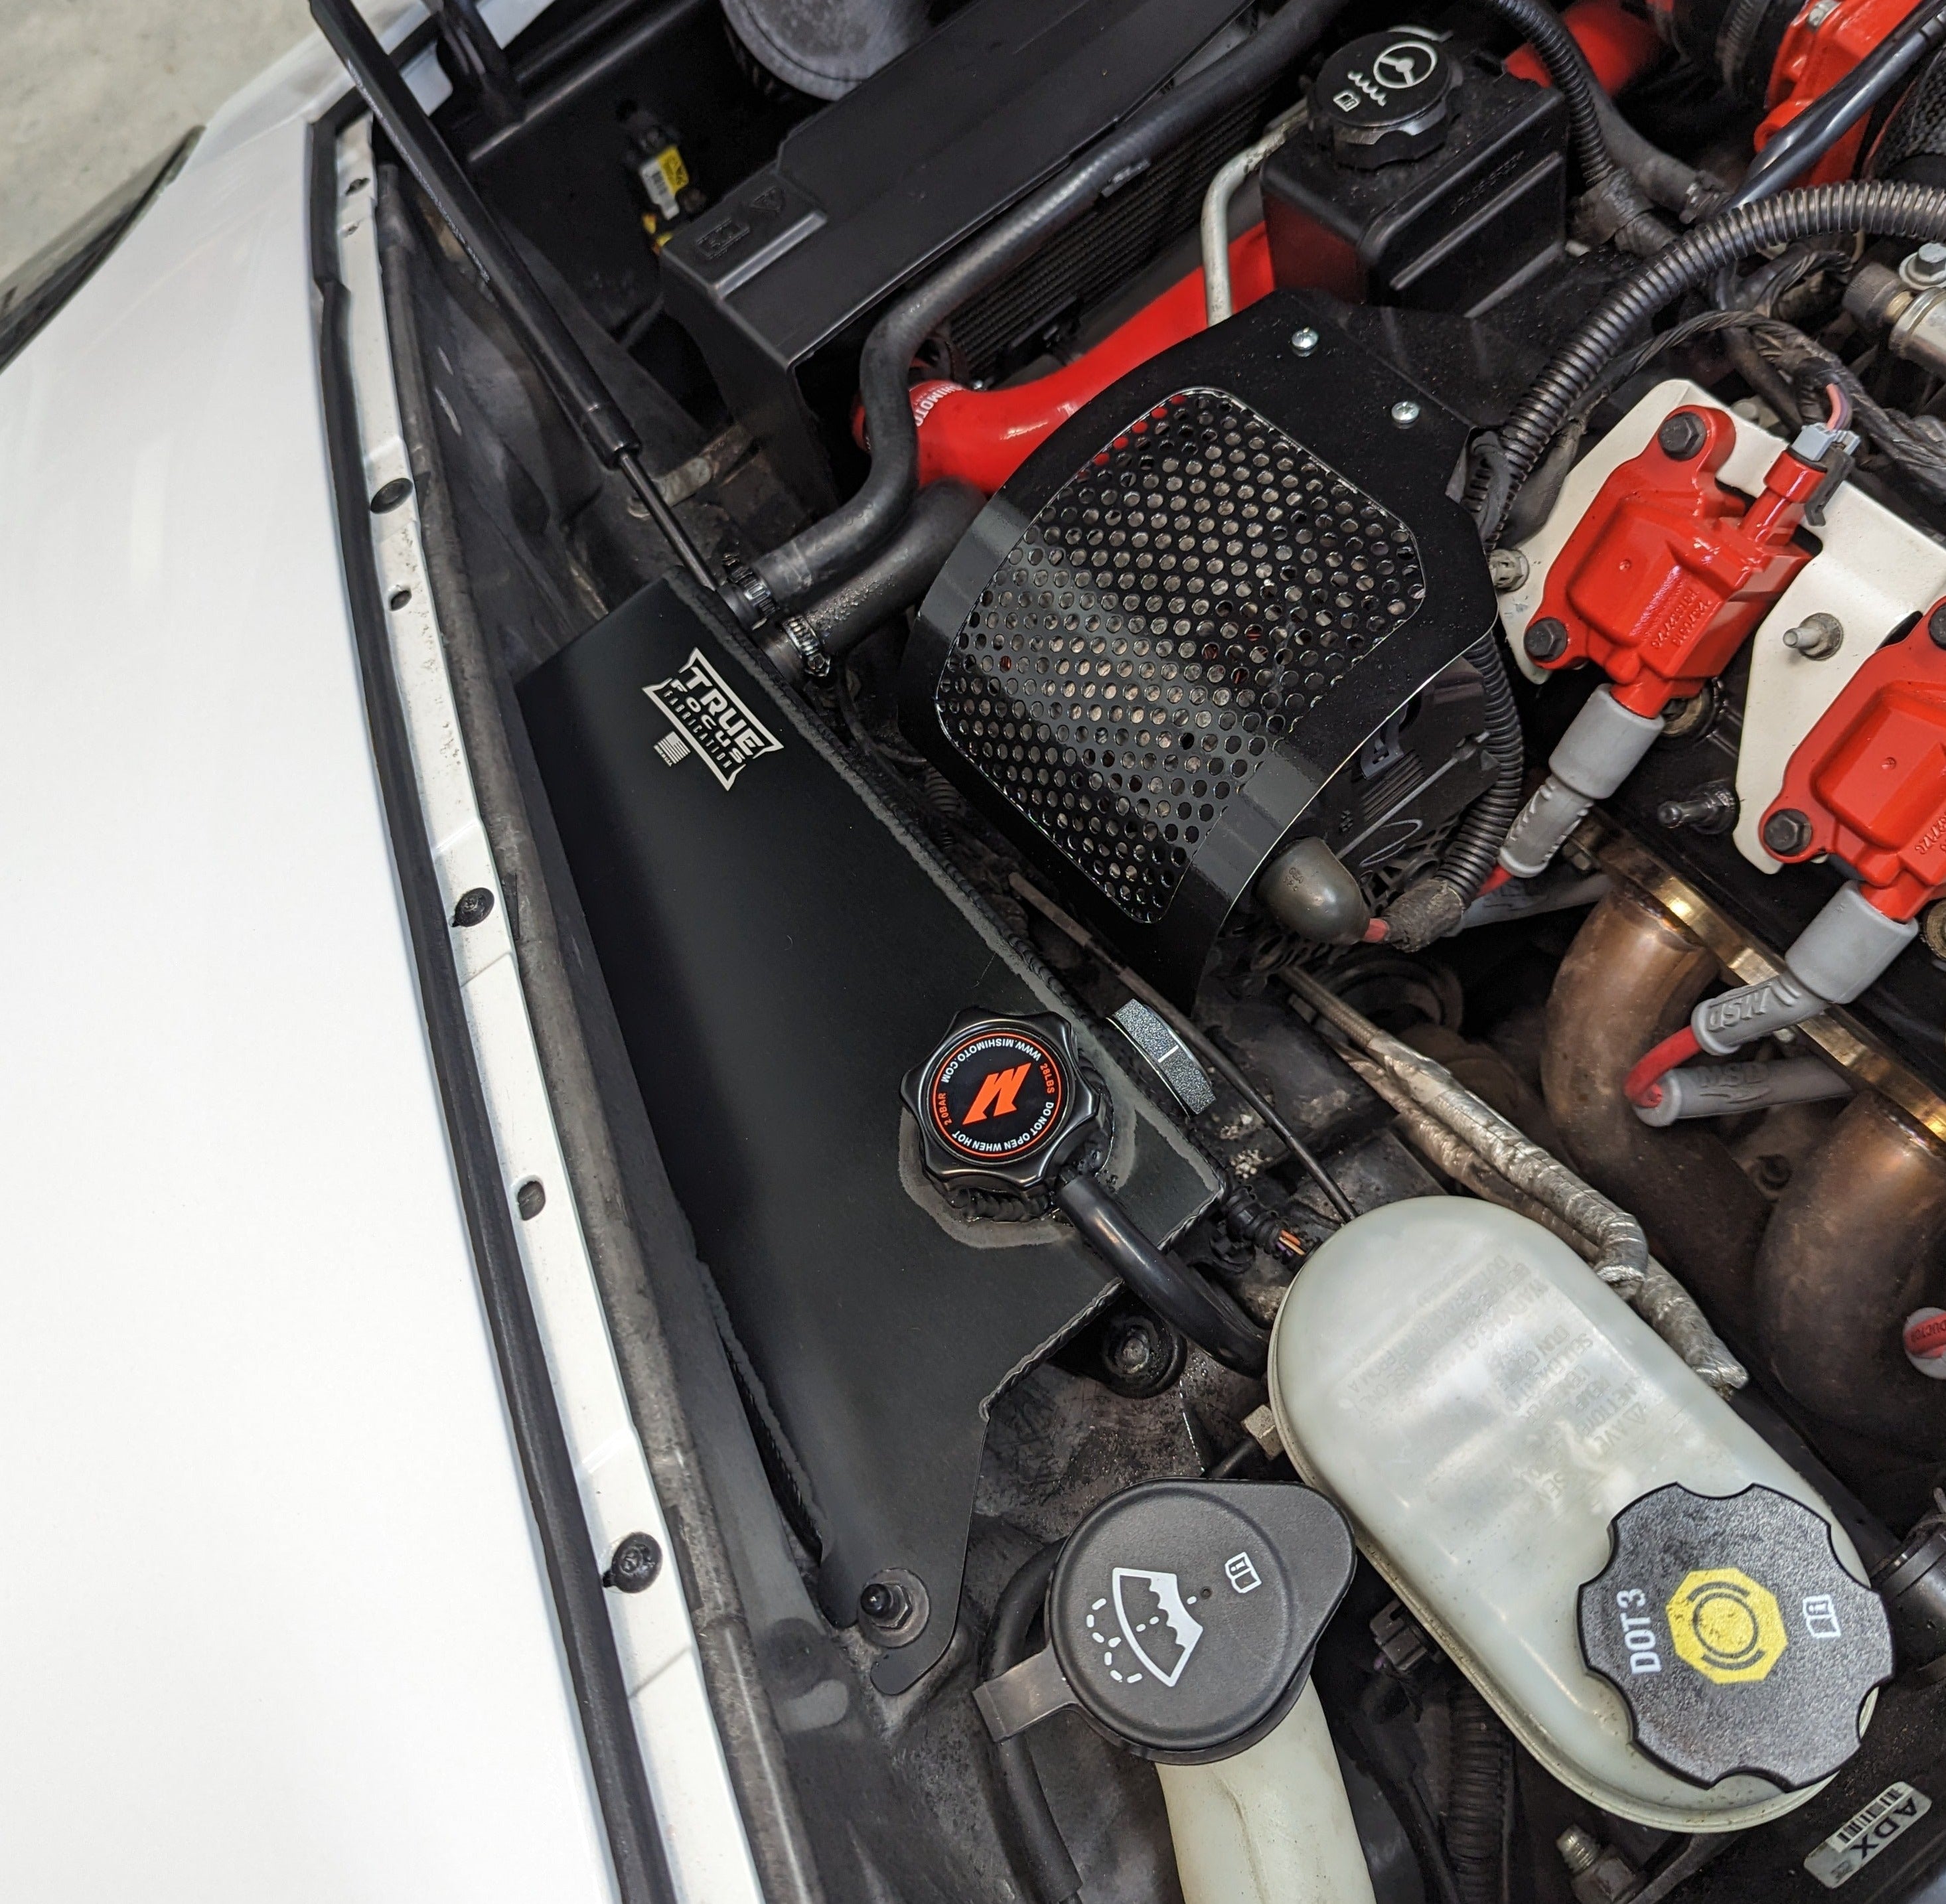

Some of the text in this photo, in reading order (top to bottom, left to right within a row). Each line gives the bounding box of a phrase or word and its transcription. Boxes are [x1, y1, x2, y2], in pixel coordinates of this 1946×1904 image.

[664, 691, 732, 769] FABRICATION
[671, 679, 747, 763] FOCUS
[686, 666, 765, 755] TRUE
[941, 1038, 1041, 1083] WWW.MISHIMOTO.COM
[1039, 1062, 1055, 1094] 28LBS
[938, 1092, 952, 1126] 2.0BAR
[952, 1102, 1054, 1151] DO NOT OPEN WHEN HOT
[1850, 1797, 1917, 1860] ADX
